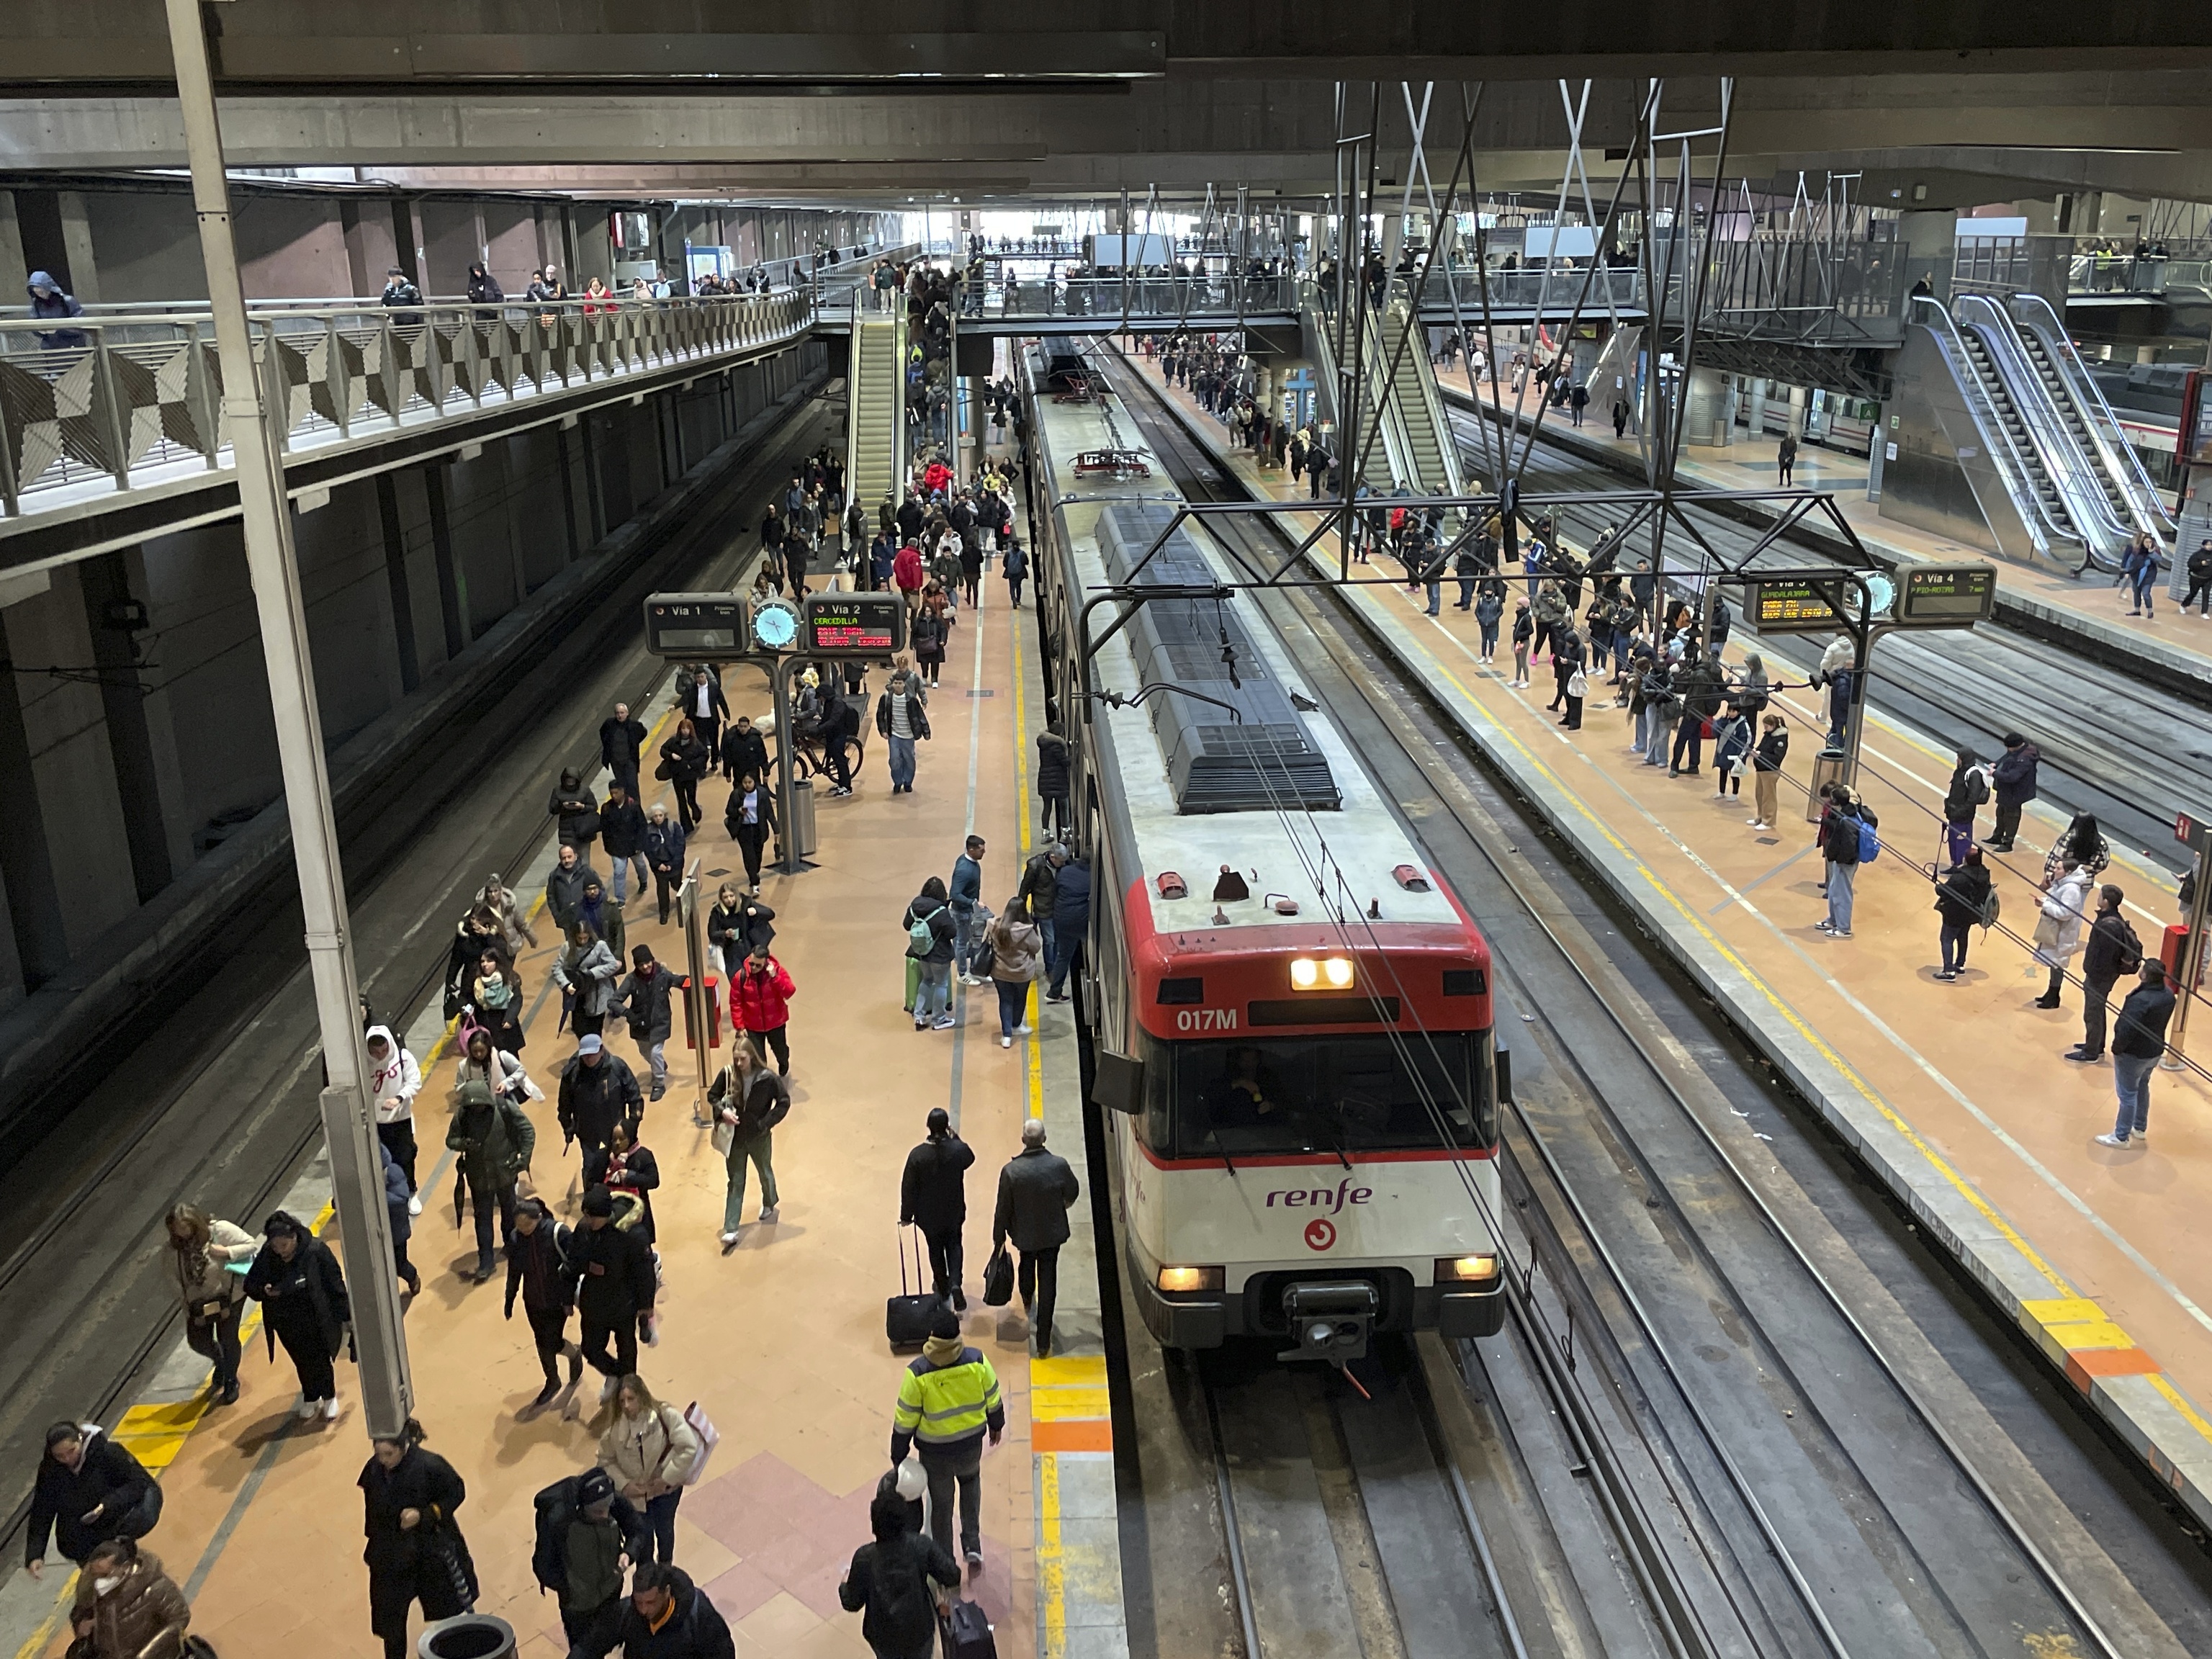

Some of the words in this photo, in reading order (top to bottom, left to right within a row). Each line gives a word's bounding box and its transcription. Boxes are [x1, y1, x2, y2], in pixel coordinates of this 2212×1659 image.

[1947, 574, 1954, 583] 4
[1761, 590, 1810, 598] GUADALAJARA
[672, 606, 689, 616] Vía
[696, 606, 701, 615] 1
[832, 604, 849, 615] Vía
[853, 605, 860, 614] 2
[1177, 1009, 1237, 1030] 017M
[1266, 1177, 1372, 1215] renfe
